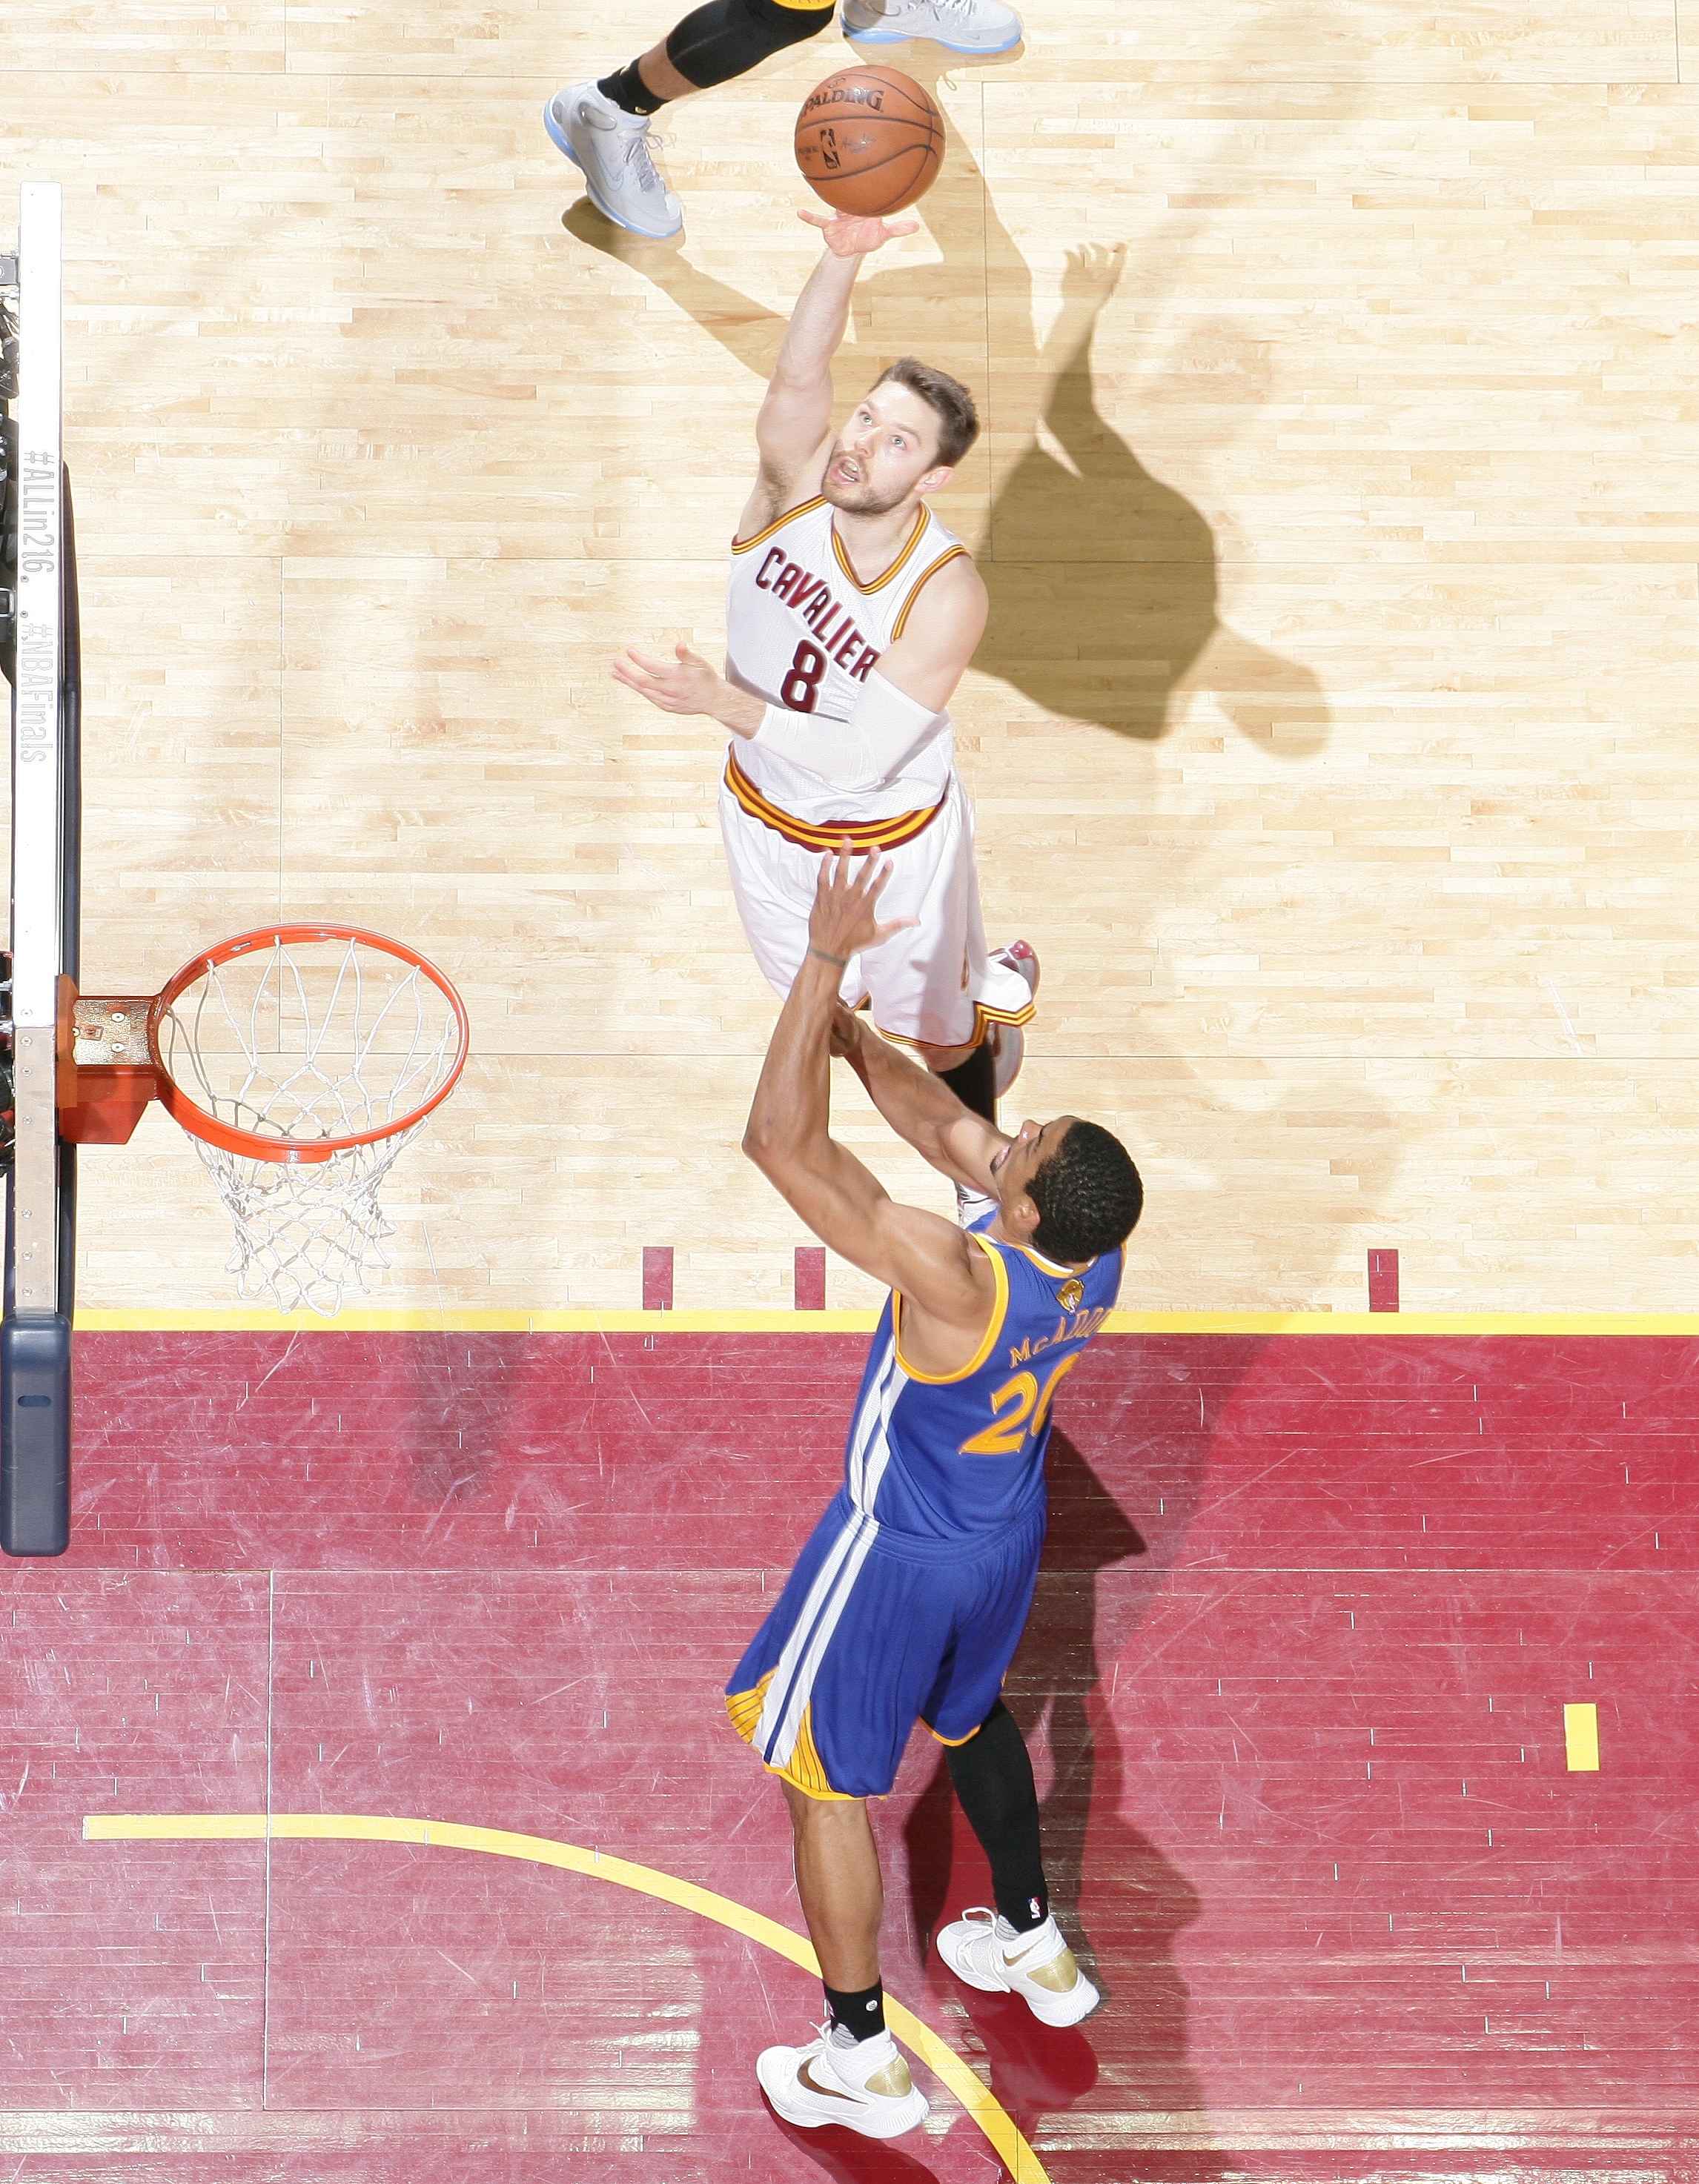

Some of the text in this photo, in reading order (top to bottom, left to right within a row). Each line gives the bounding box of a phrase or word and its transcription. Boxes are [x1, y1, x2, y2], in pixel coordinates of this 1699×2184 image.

[801, 87, 884, 116] PALDING
[756, 546, 882, 683] CAVALIER
[781, 640, 828, 714] 8
